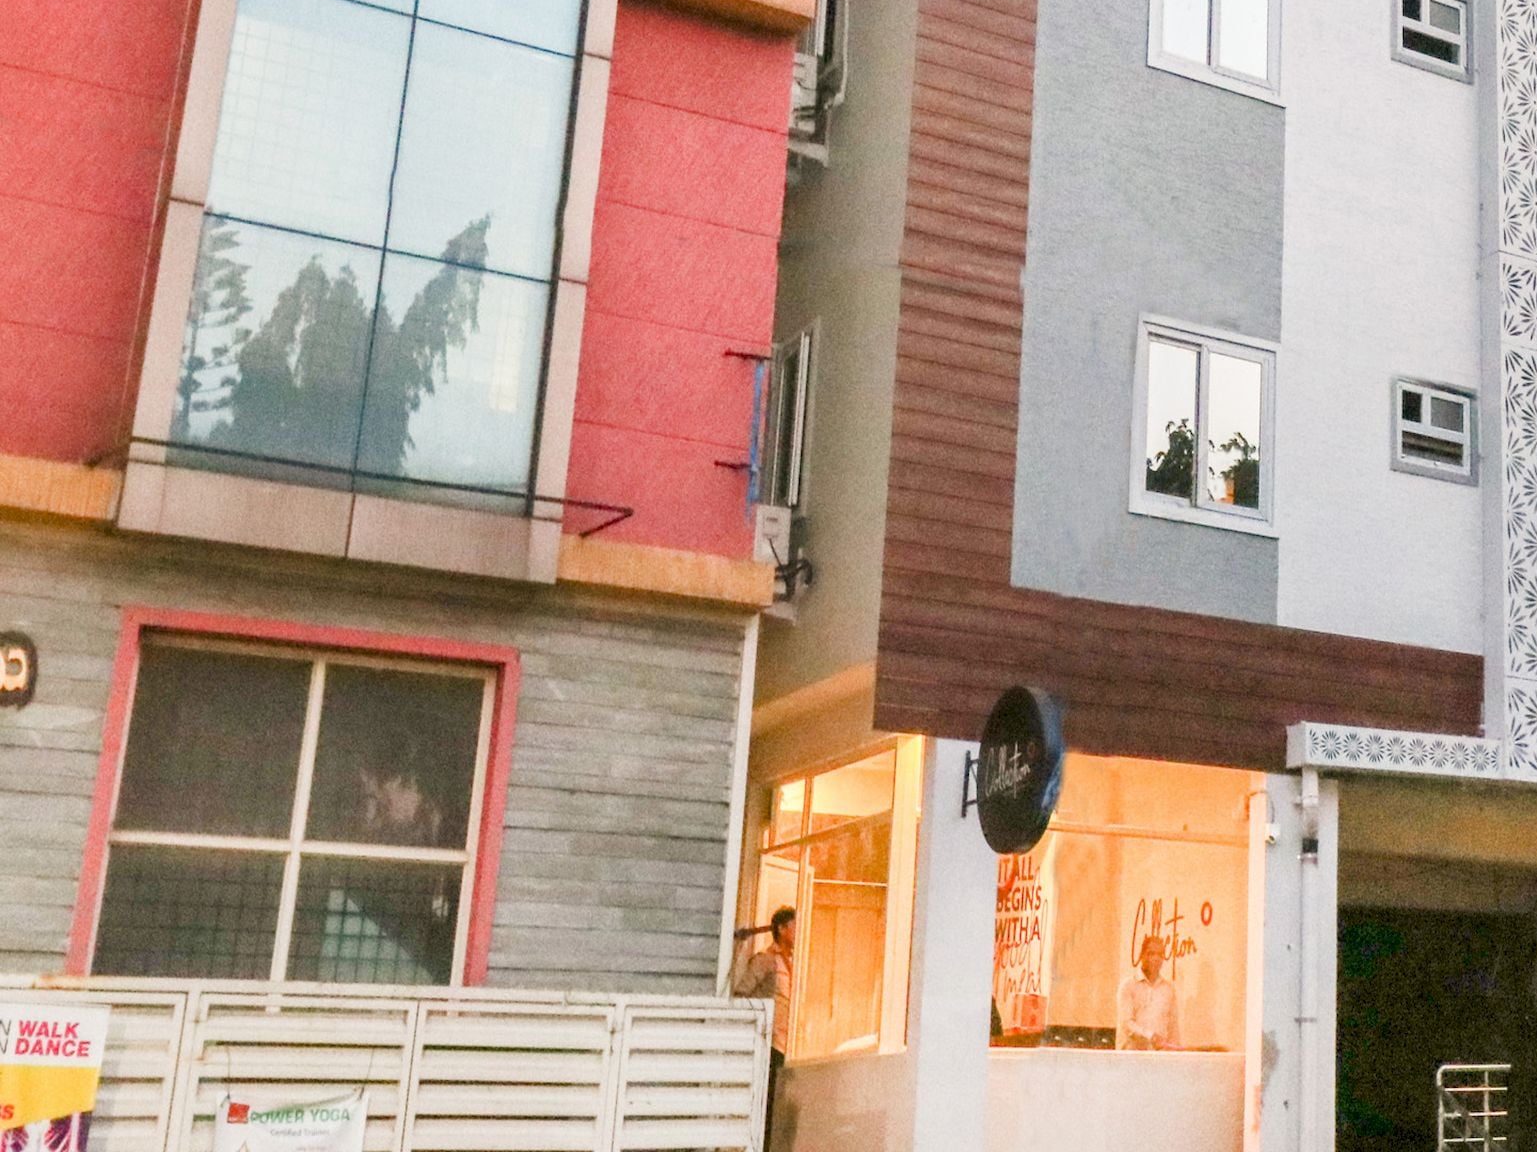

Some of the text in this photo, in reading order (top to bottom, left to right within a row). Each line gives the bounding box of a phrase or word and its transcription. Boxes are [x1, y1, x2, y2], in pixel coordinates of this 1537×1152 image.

[996, 885, 1042, 913] BEGINS
[995, 915, 1041, 944] WITH A
[18, 1019, 80, 1039] WALK
[14, 1038, 91, 1057] DANCE
[250, 1108, 350, 1124] POWER YOGA
